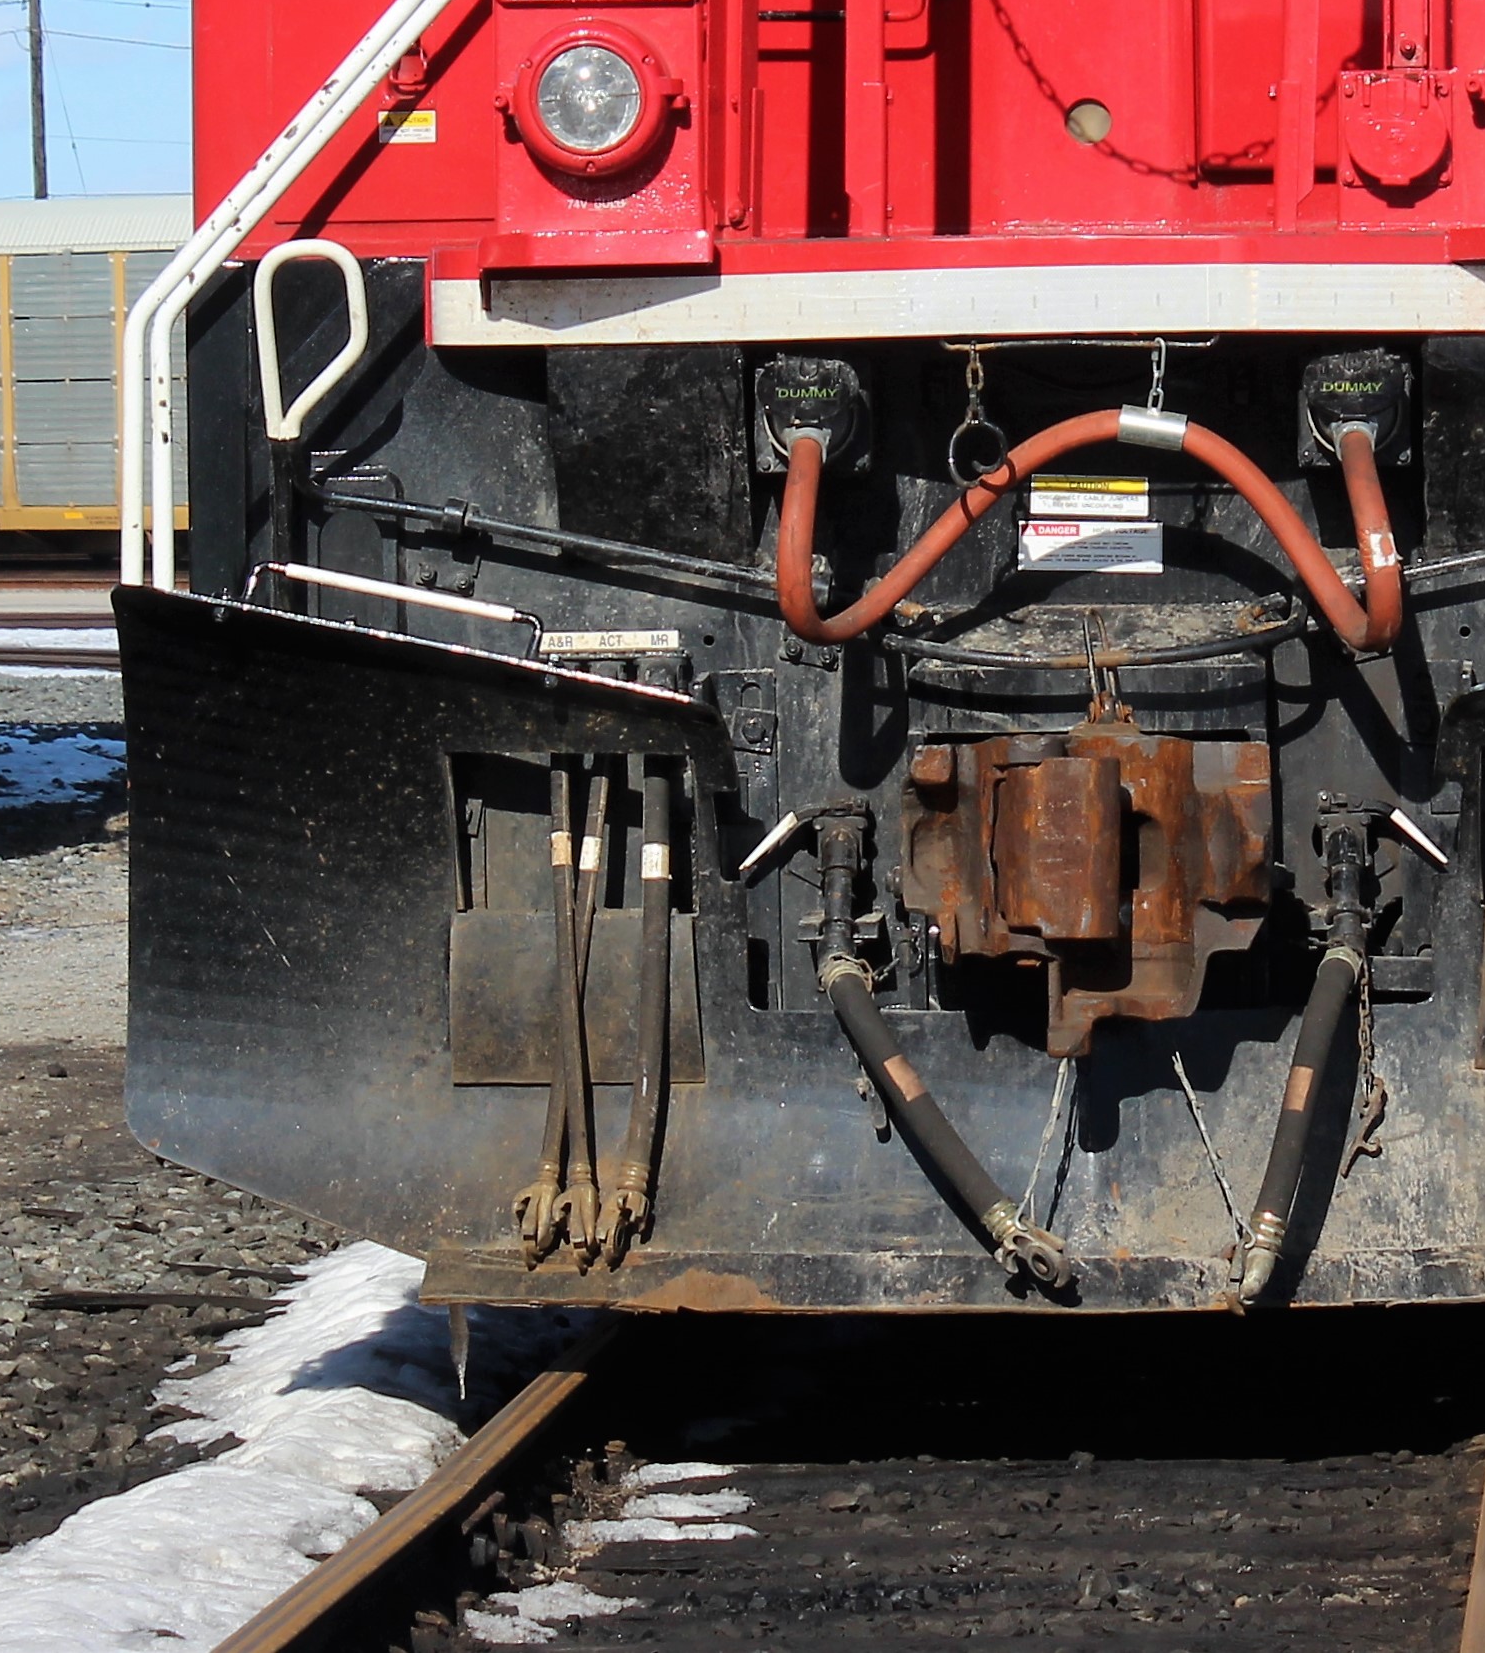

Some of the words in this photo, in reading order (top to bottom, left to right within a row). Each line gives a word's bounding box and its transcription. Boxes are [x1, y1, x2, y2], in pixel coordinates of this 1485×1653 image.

[1321, 382, 1383, 392] DUMMY
[777, 388, 837, 398] DUMMY
[1037, 525, 1078, 535] DANGER
[547, 635, 574, 648] A&R
[598, 634, 623, 647] ACT
